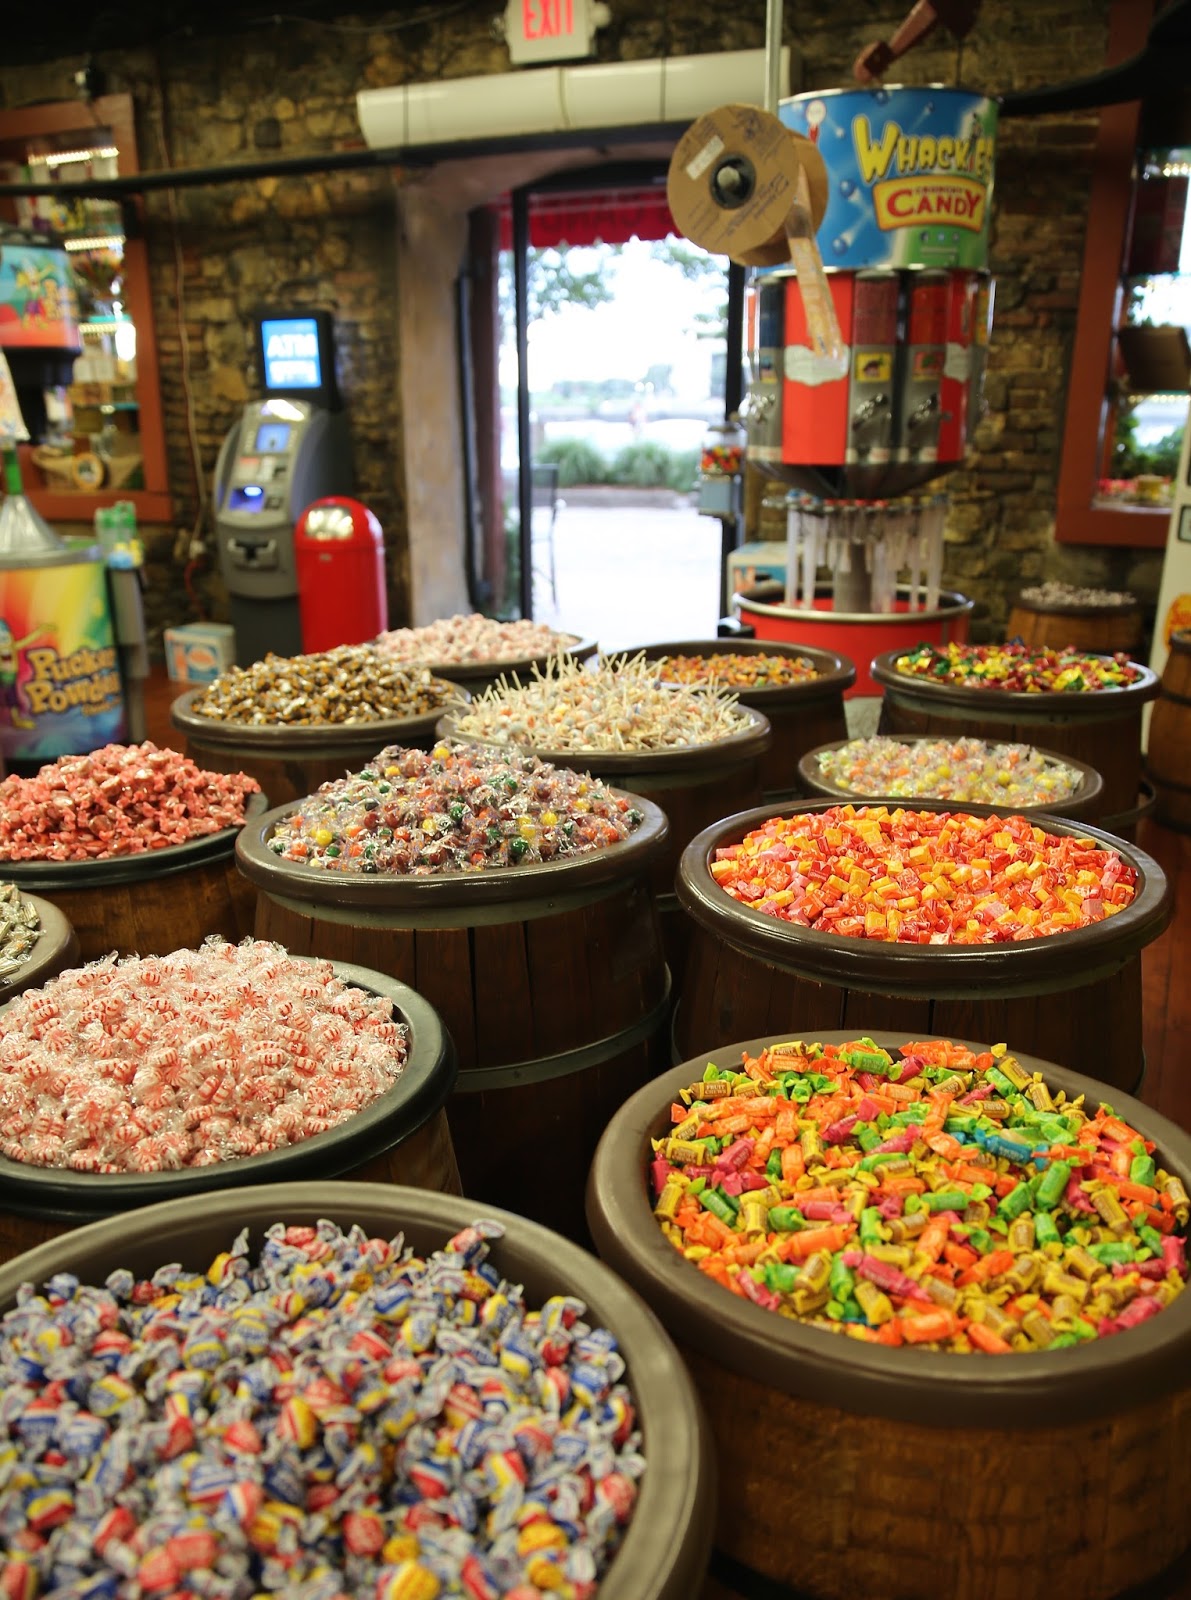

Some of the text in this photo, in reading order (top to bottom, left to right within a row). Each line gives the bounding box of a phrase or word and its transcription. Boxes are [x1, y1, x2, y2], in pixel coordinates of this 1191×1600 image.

[522, 0, 574, 40] EXIT
[886, 189, 981, 219] CANDY
[267, 333, 317, 358] ATM
